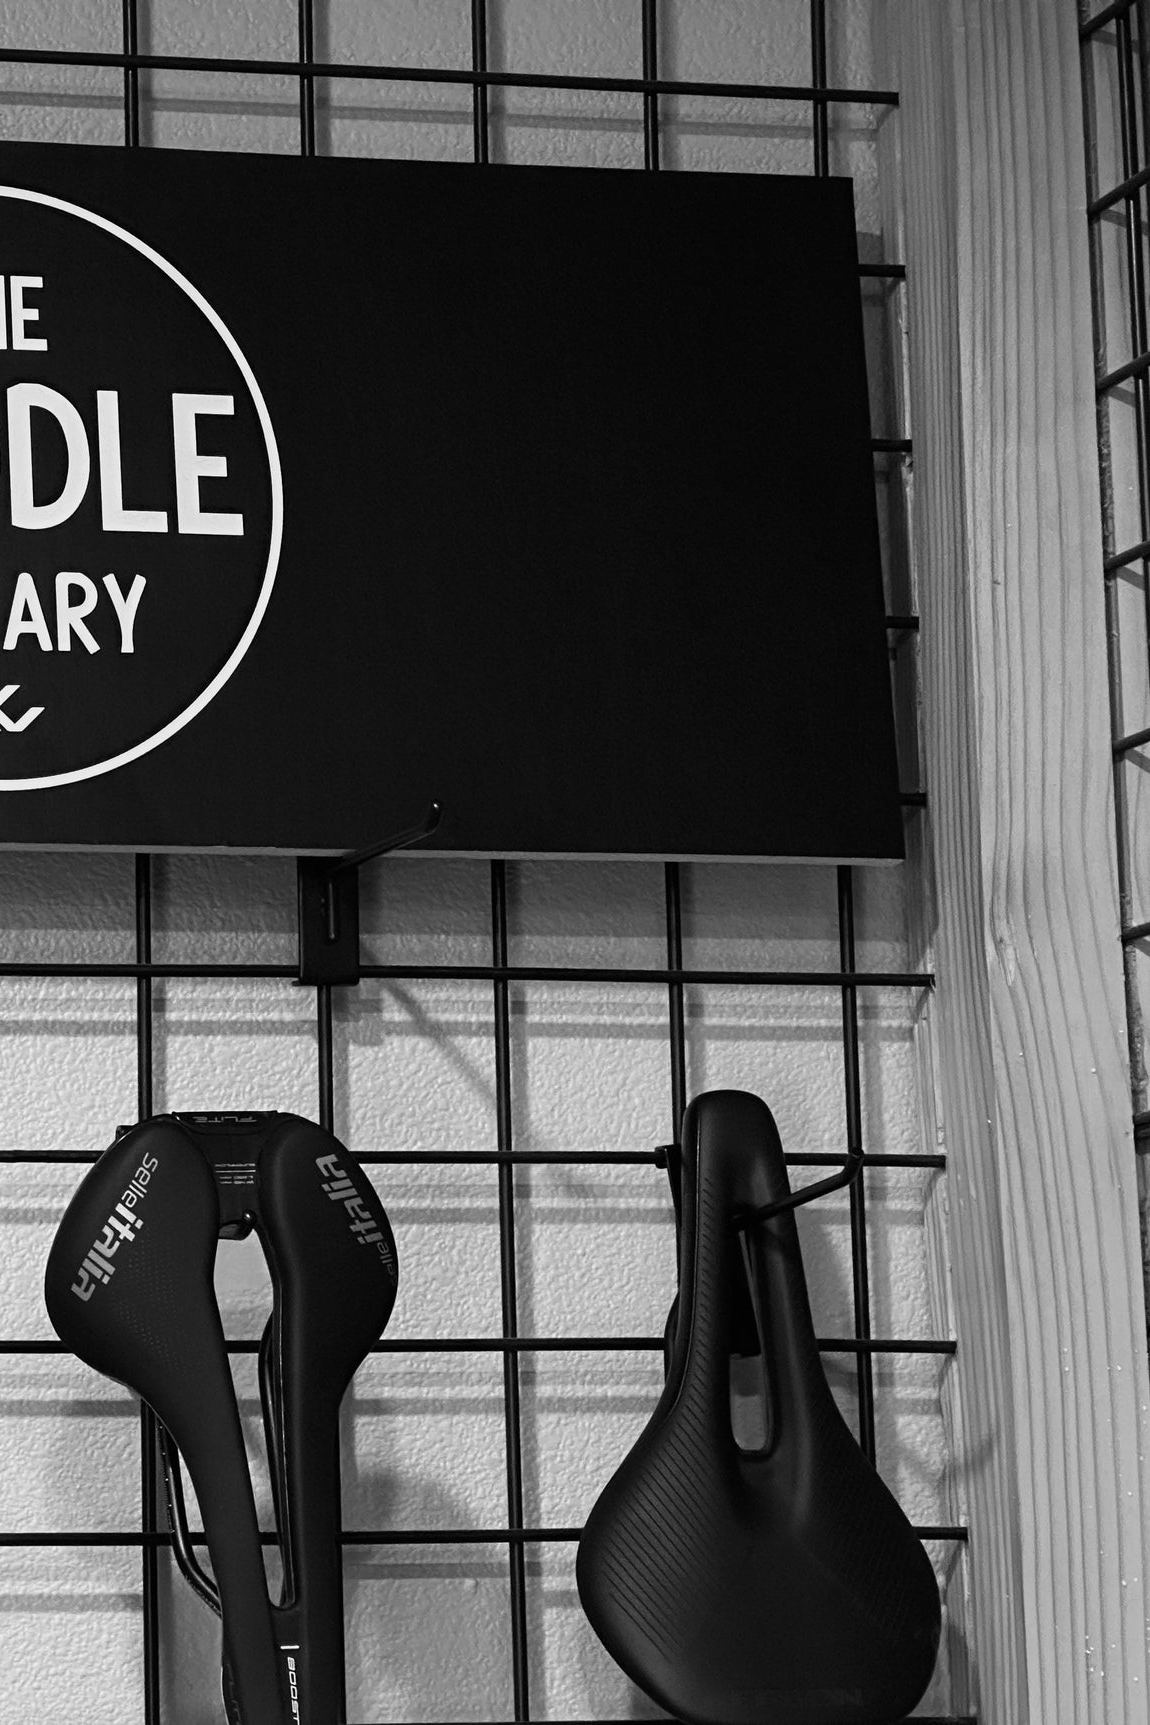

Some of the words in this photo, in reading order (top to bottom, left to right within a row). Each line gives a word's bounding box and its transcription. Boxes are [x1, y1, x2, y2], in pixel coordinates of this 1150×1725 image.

[315, 1153, 384, 1245] italia
[70, 1202, 144, 1302] italia
[287, 1656, 299, 1725] BOOST
